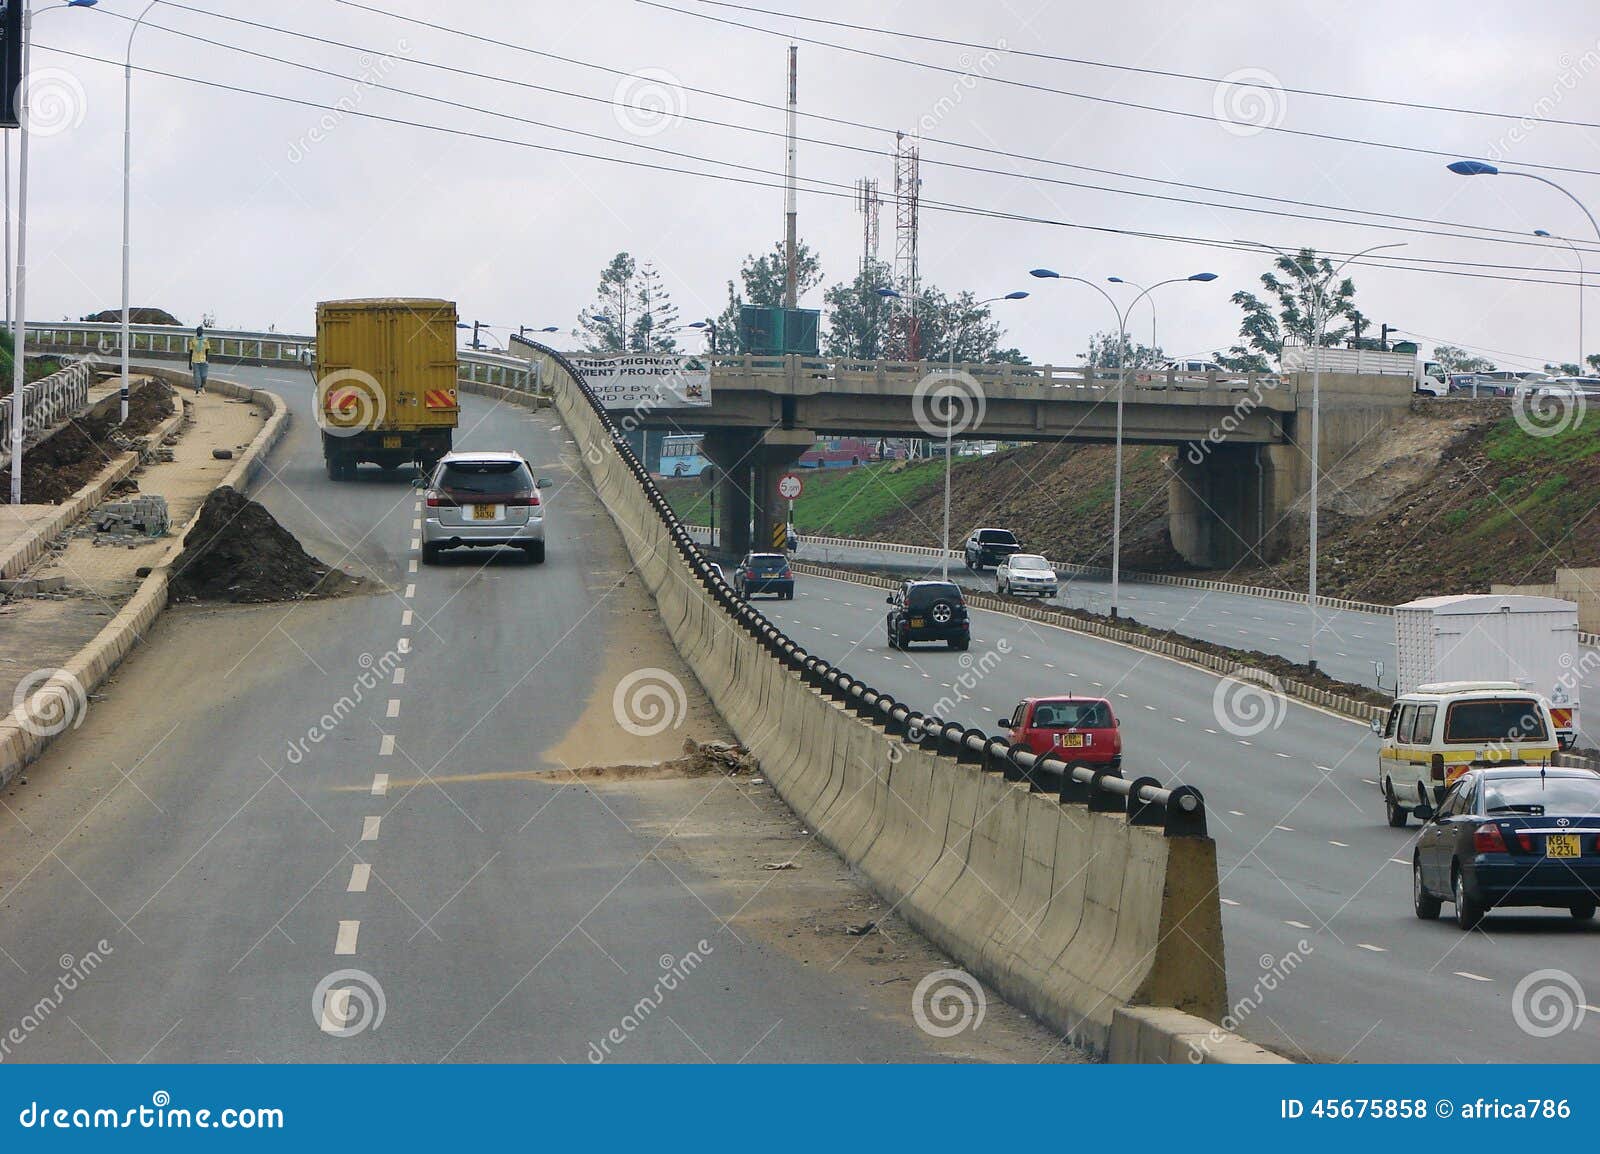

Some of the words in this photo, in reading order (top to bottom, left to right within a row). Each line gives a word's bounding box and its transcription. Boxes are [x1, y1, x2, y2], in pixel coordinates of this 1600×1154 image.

[575, 359, 616, 368] THIKA
[620, 368, 679, 376] PROJECT
[1549, 835, 1571, 846] KBL
